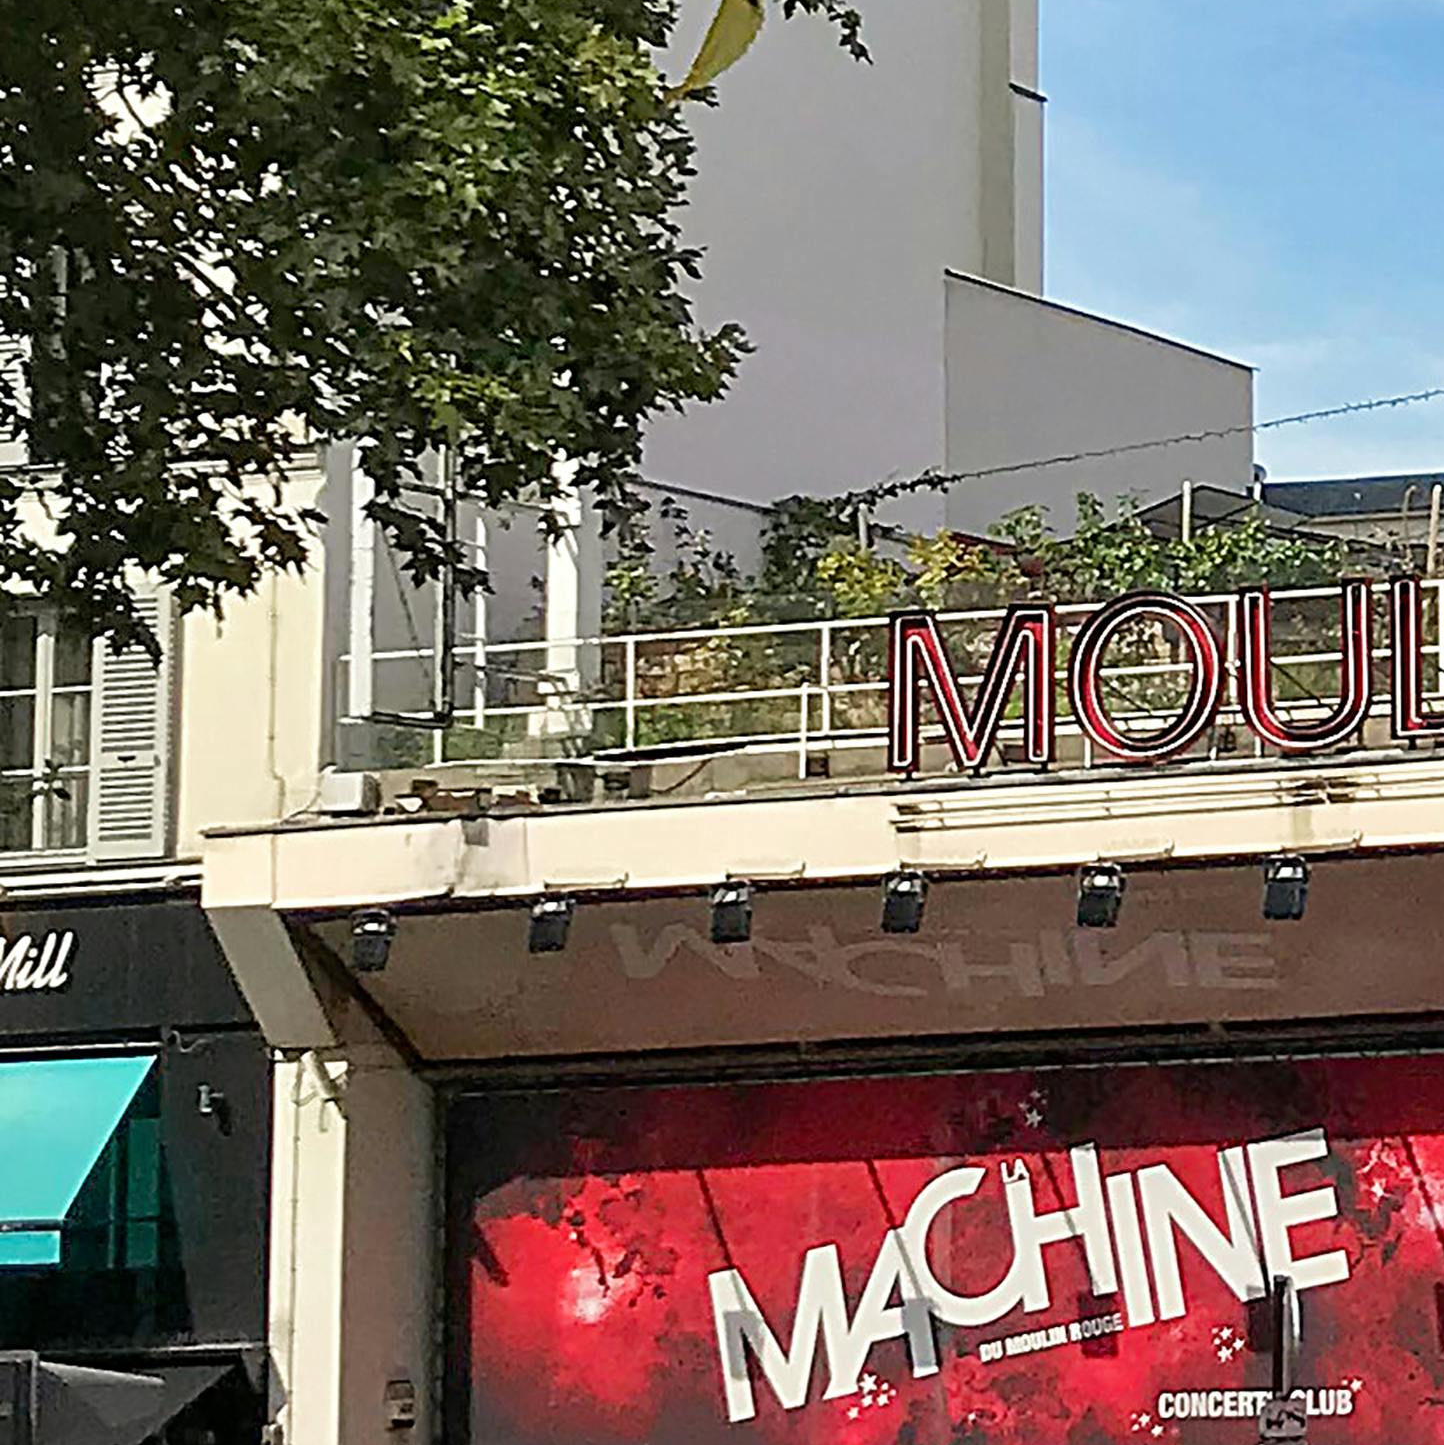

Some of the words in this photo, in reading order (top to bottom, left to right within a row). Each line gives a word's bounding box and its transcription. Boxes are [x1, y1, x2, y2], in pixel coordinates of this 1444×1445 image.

[1001, 1158, 1030, 1184] LA
[708, 1127, 1350, 1424] MACHINE
[979, 1340, 1003, 1364] DU
[1005, 1325, 1068, 1357] MOULIN
[1069, 1313, 1124, 1341] ROUGE
